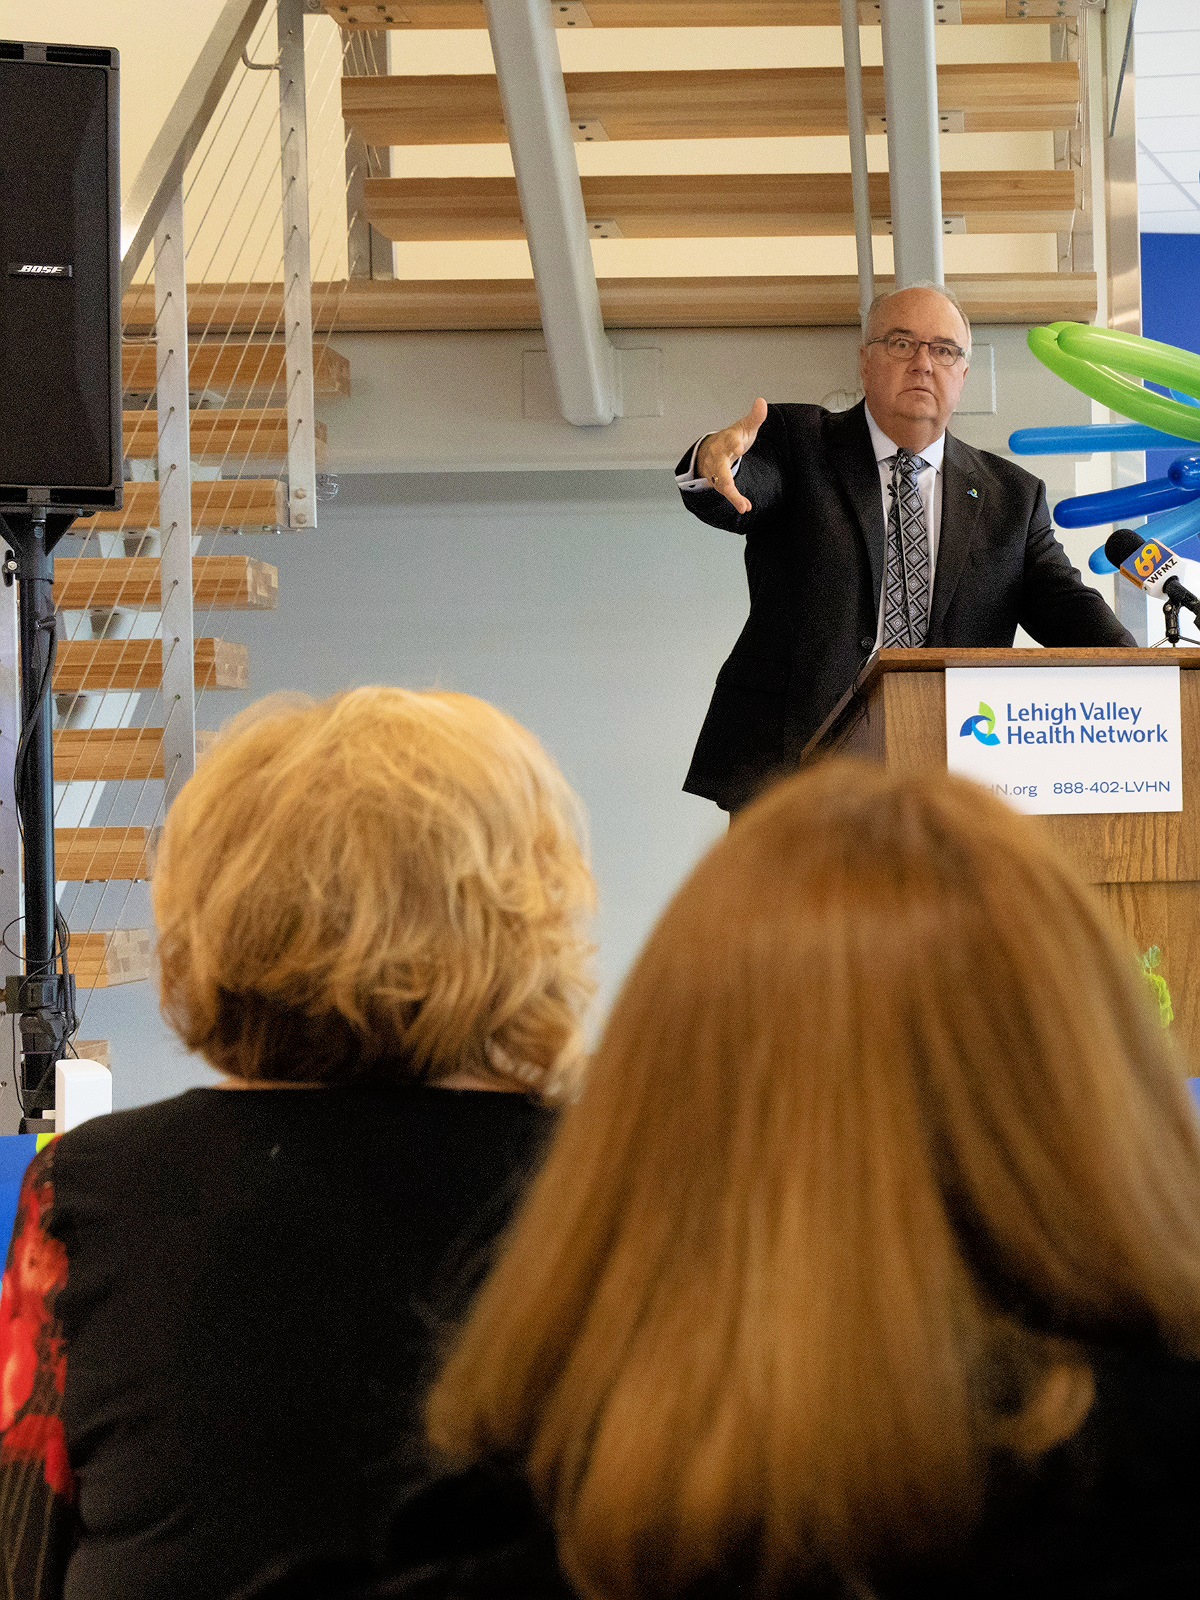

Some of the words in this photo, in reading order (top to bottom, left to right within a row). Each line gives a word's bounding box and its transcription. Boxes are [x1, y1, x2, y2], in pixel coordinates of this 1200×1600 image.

[18, 264, 65, 274] BOSE
[1133, 543, 1163, 578] 69
[1146, 557, 1178, 584] WFMZ
[1006, 702, 1077, 725] Lehigh
[1079, 701, 1142, 725] Valley
[1007, 724, 1075, 745] Health
[1080, 723, 1169, 744] Network
[1053, 780, 1171, 795] 888-402-LVHN
